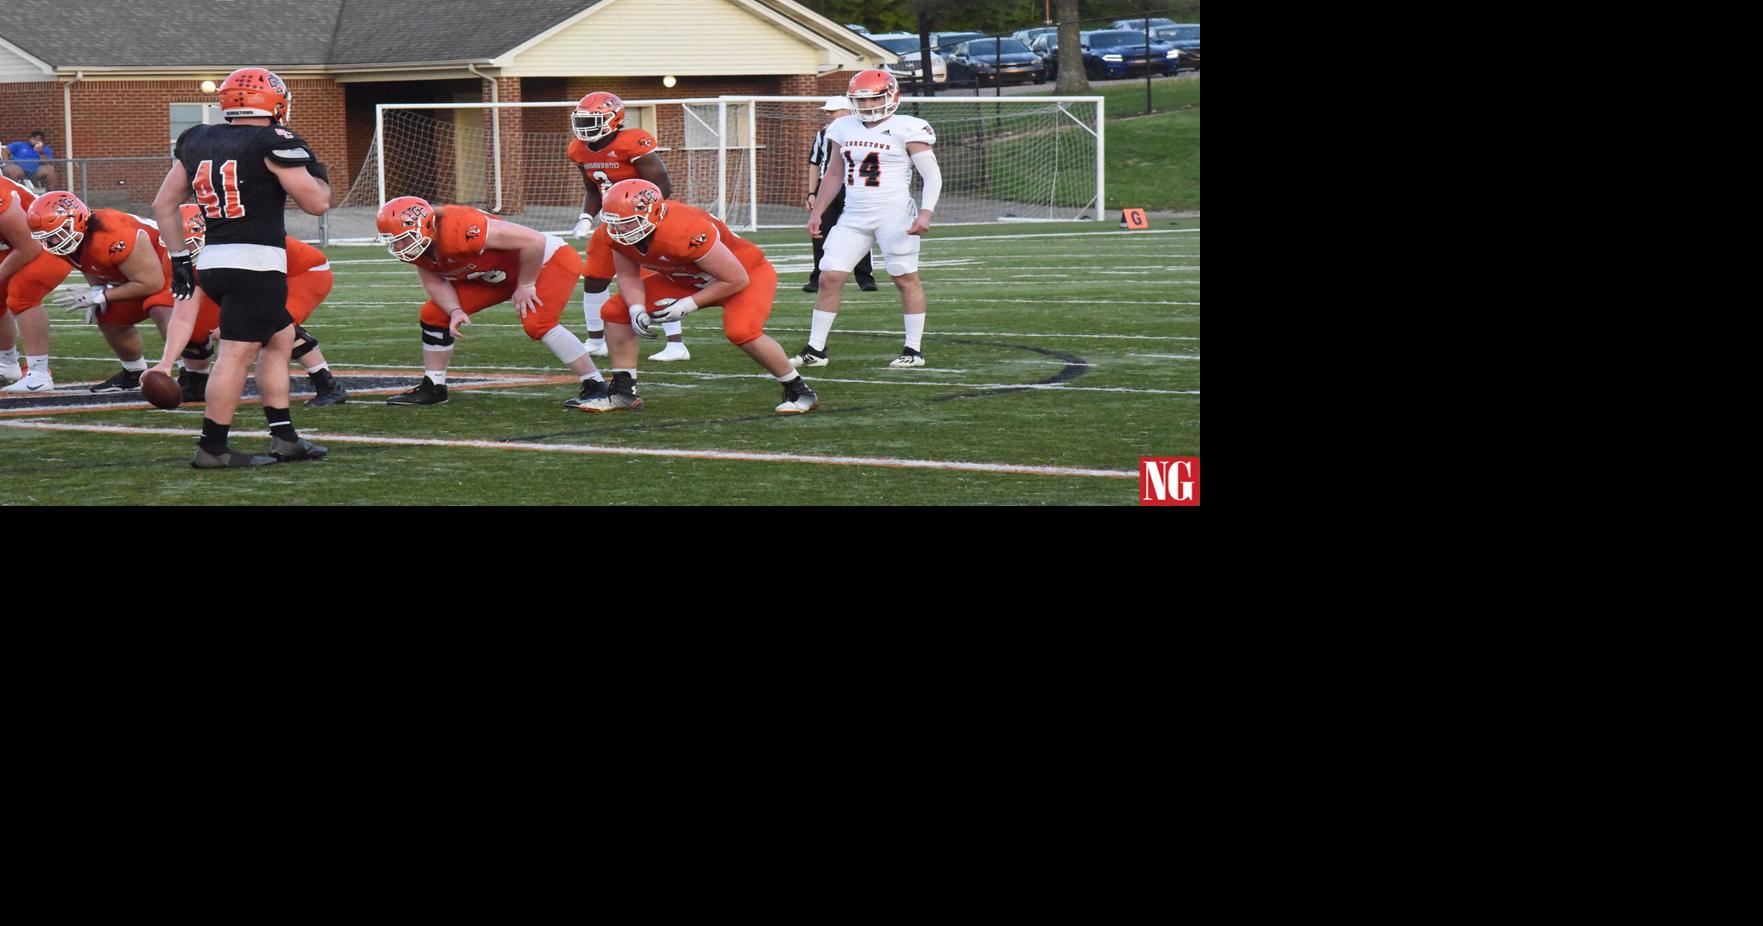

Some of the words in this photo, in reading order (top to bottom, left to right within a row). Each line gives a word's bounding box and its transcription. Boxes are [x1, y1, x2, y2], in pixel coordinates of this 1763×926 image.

[843, 150, 881, 187] 14
[192, 160, 245, 218] 41
[1131, 210, 1143, 226] G
